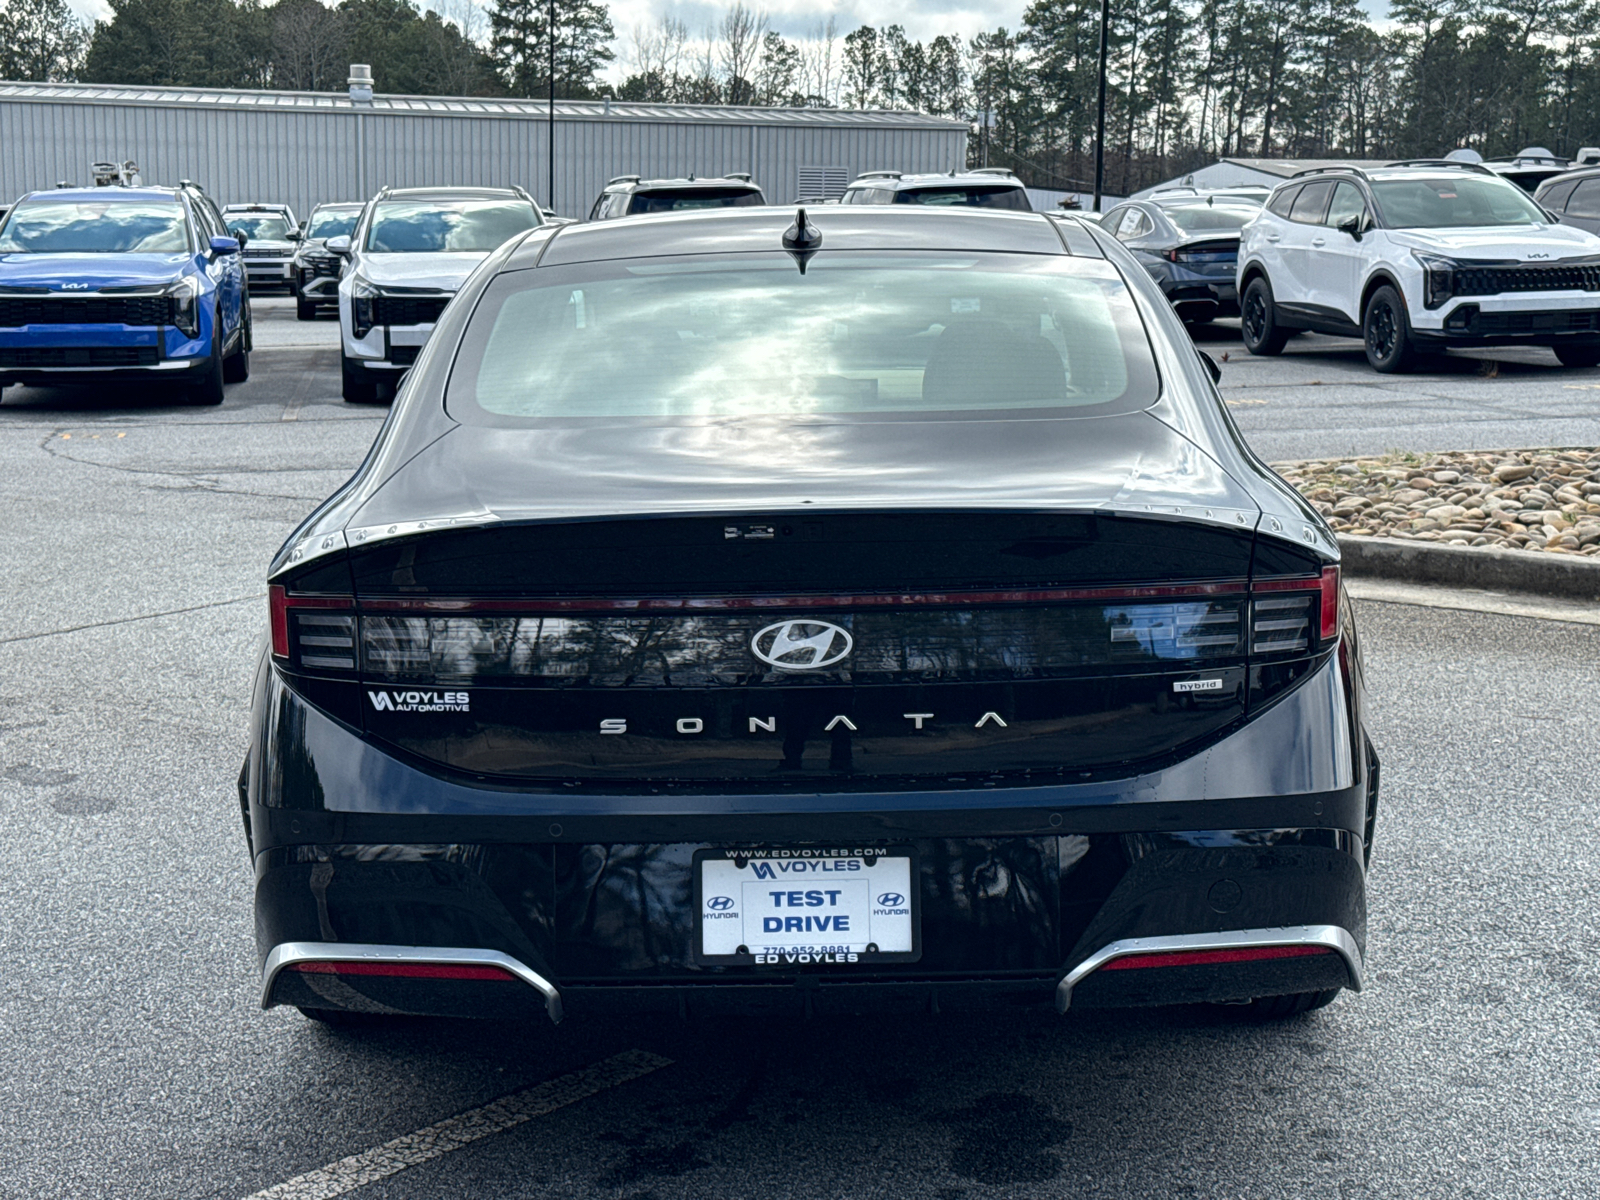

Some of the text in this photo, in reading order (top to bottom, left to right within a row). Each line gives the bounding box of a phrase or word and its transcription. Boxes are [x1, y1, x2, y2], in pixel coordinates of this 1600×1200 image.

[1180, 682, 1216, 690] hybrid
[393, 691, 470, 703] VOYLES
[396, 704, 470, 712] AUTOMOTIVE
[726, 848, 887, 858] WWW.EDVOYLES.COM
[777, 860, 861, 872] VOYLES
[769, 890, 842, 907] TEST
[763, 916, 850, 932] DRIVE
[755, 954, 858, 964] ED VOYLES
